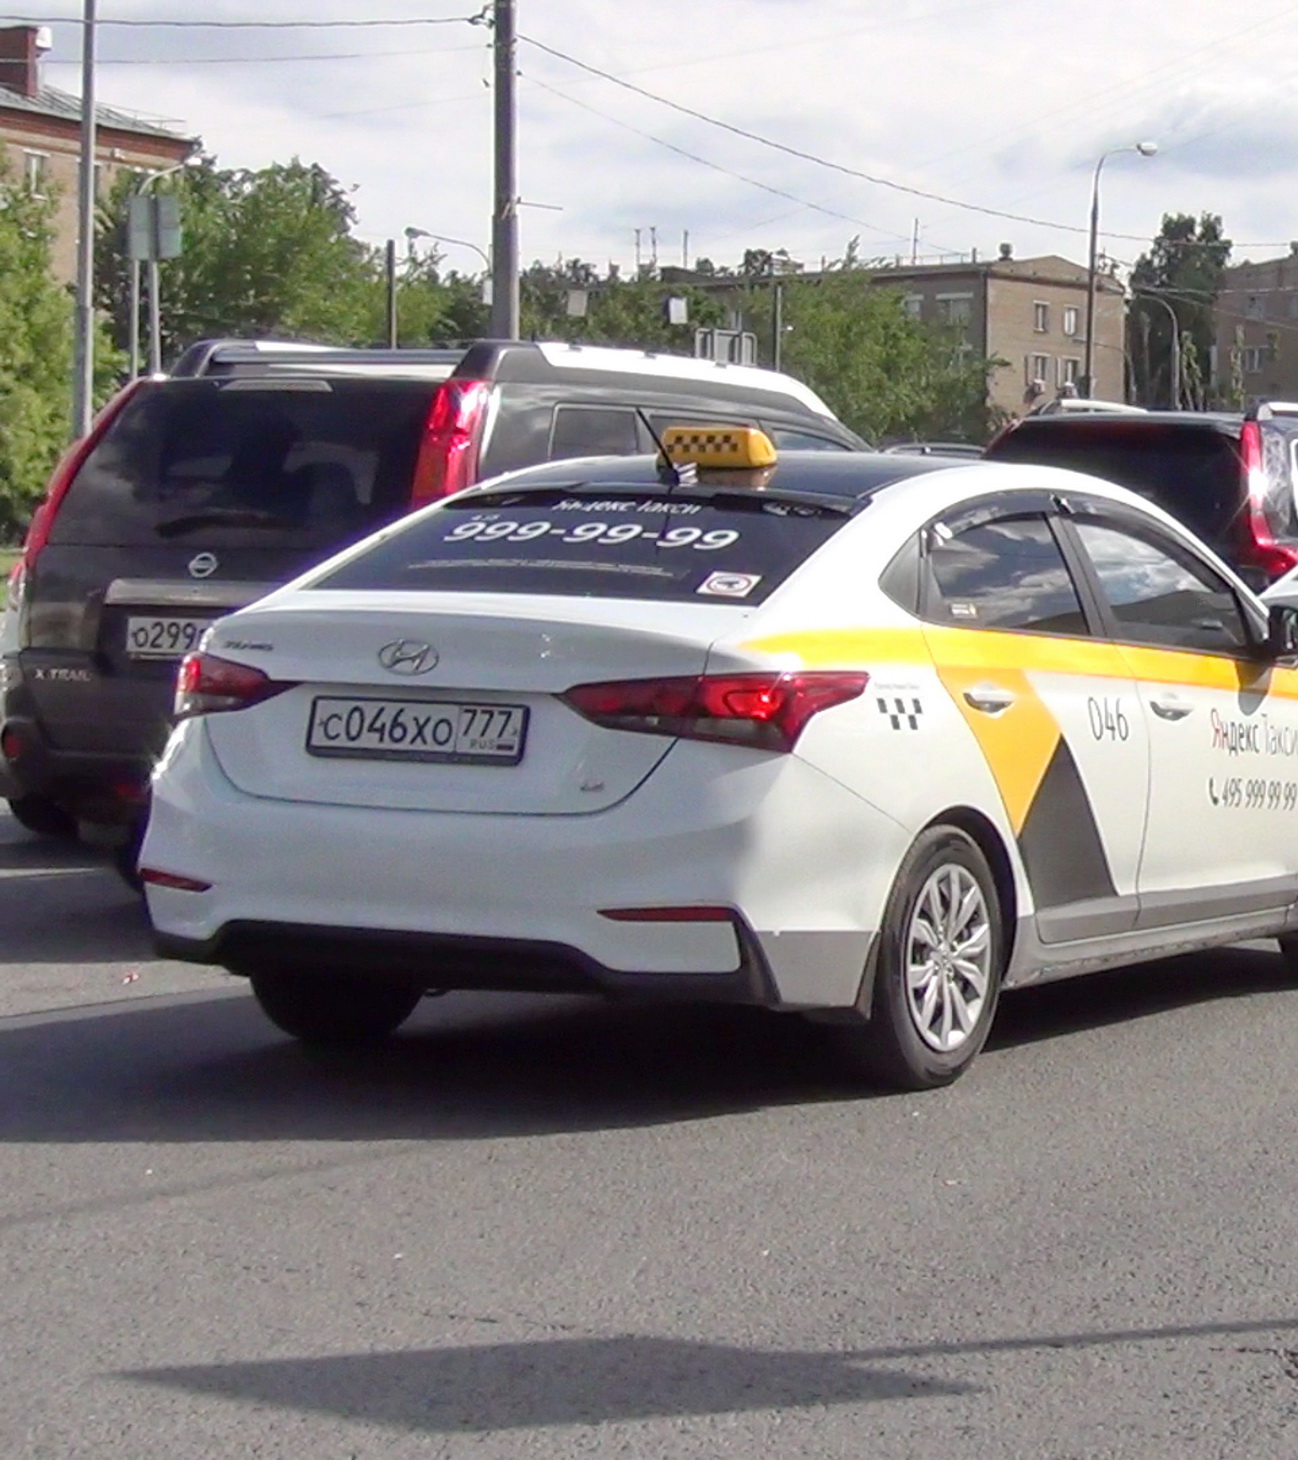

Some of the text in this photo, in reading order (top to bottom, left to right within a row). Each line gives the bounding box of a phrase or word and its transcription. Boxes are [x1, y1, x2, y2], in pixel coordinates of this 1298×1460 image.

[444, 520, 741, 551] 999-99-99
[461, 708, 513, 739] 777
[1087, 696, 1130, 742] 046
[1210, 707, 1298, 757] Яндекс Такси
[469, 738, 495, 751] RUS
[1221, 777, 1298, 812] 495 999 99 99
